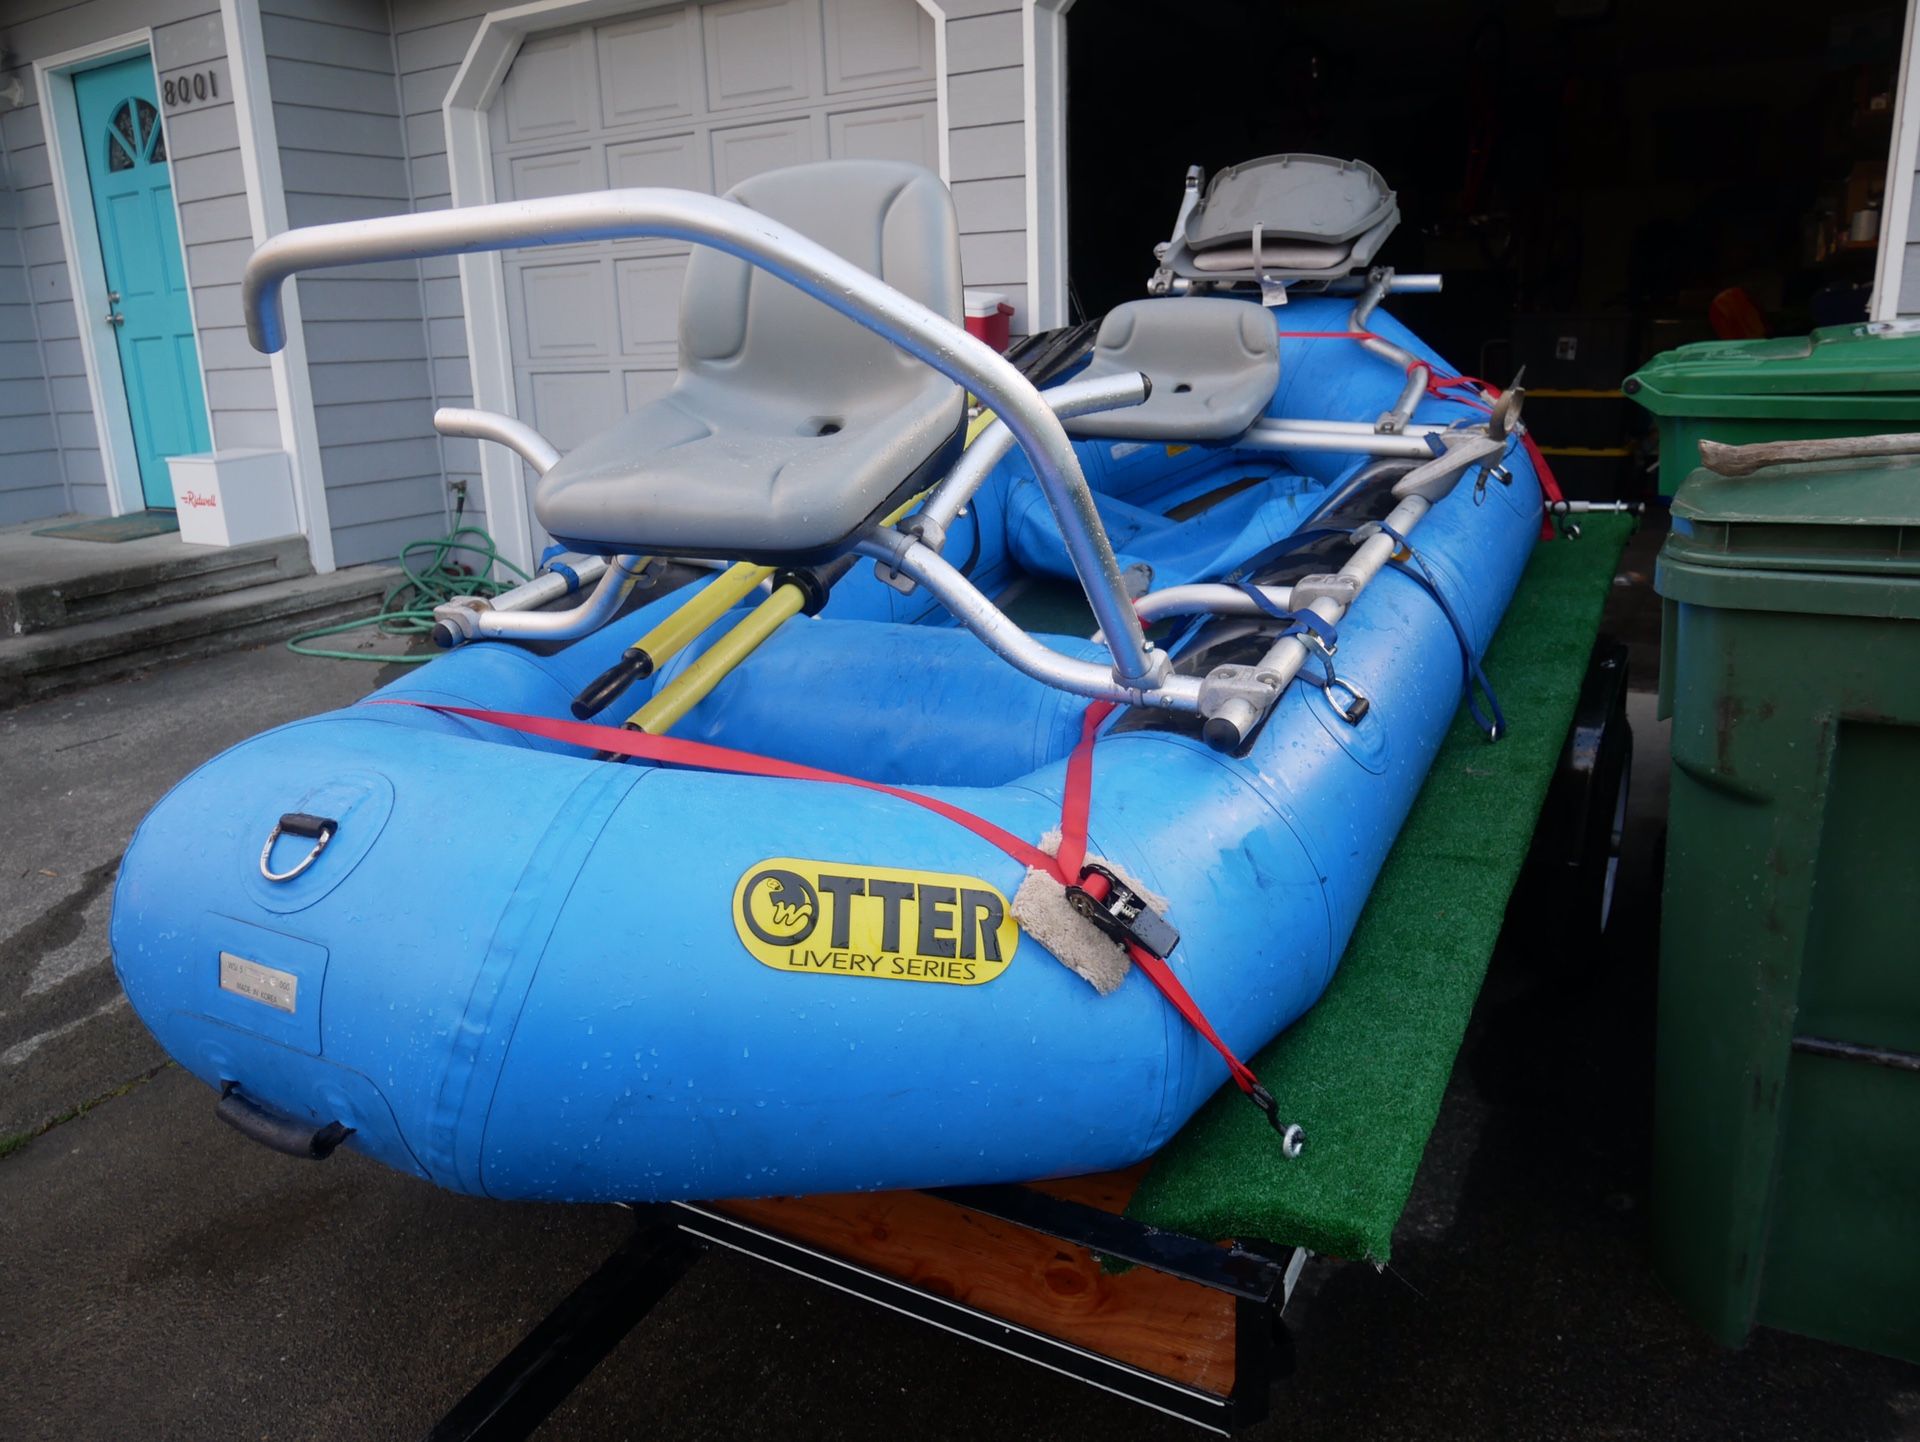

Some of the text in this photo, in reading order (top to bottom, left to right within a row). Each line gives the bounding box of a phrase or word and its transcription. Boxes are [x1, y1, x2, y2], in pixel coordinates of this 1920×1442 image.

[164, 70, 218, 107] 8001
[742, 869, 1004, 963] OTTER
[789, 949, 977, 981] LIVERY SERIES
